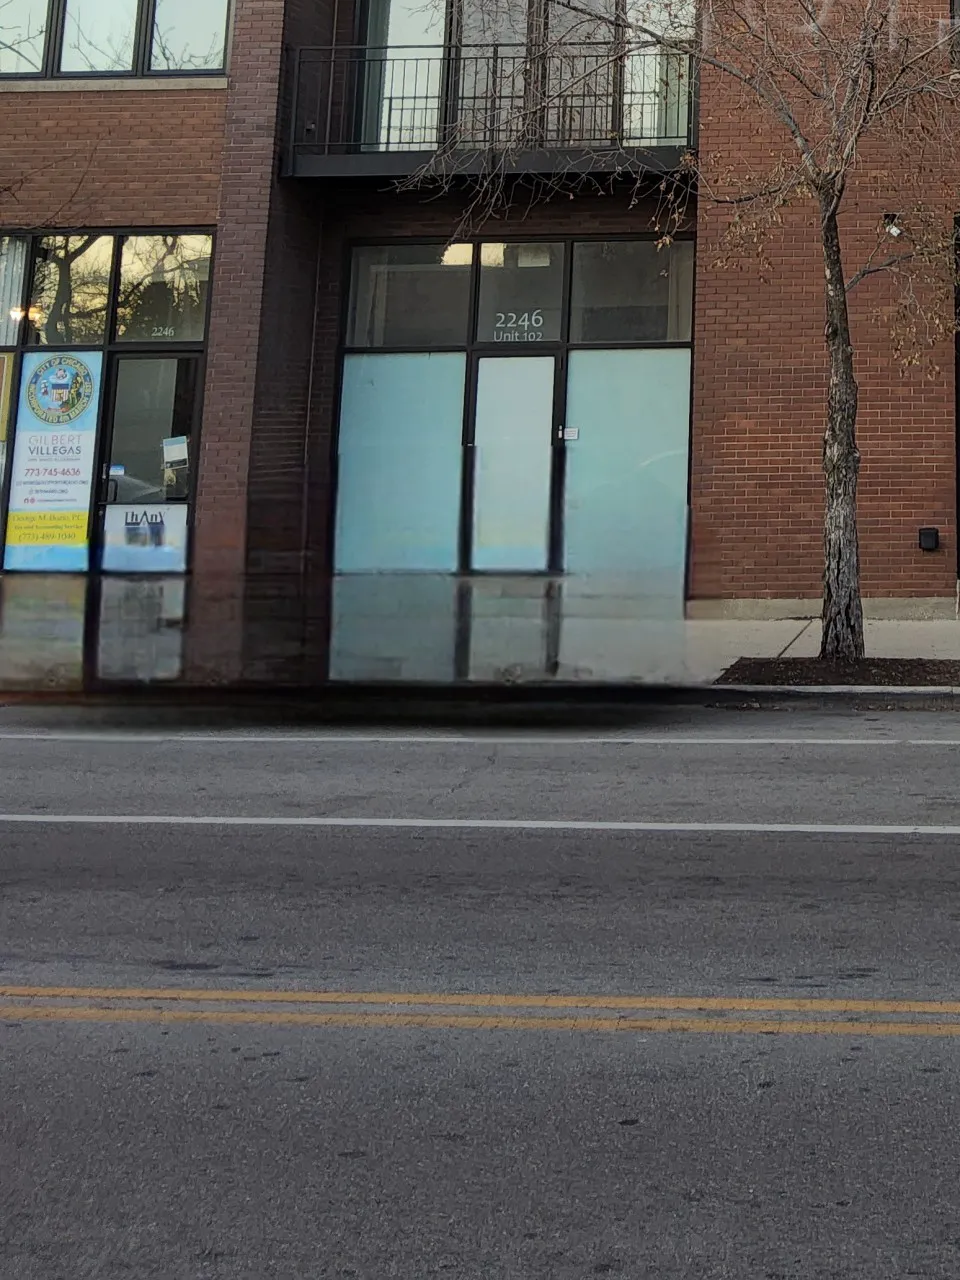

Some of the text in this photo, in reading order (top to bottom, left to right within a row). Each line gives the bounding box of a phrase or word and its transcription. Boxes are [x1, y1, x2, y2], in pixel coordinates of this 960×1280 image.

[495, 309, 544, 331] 2246
[151, 326, 175, 337] 2246
[493, 330, 543, 342] Unit 102
[36, 362, 51, 376] CITY
[50, 357, 60, 367] OF
[28, 434, 83, 445] GILBERT
[28, 446, 82, 456] VILLEGAS
